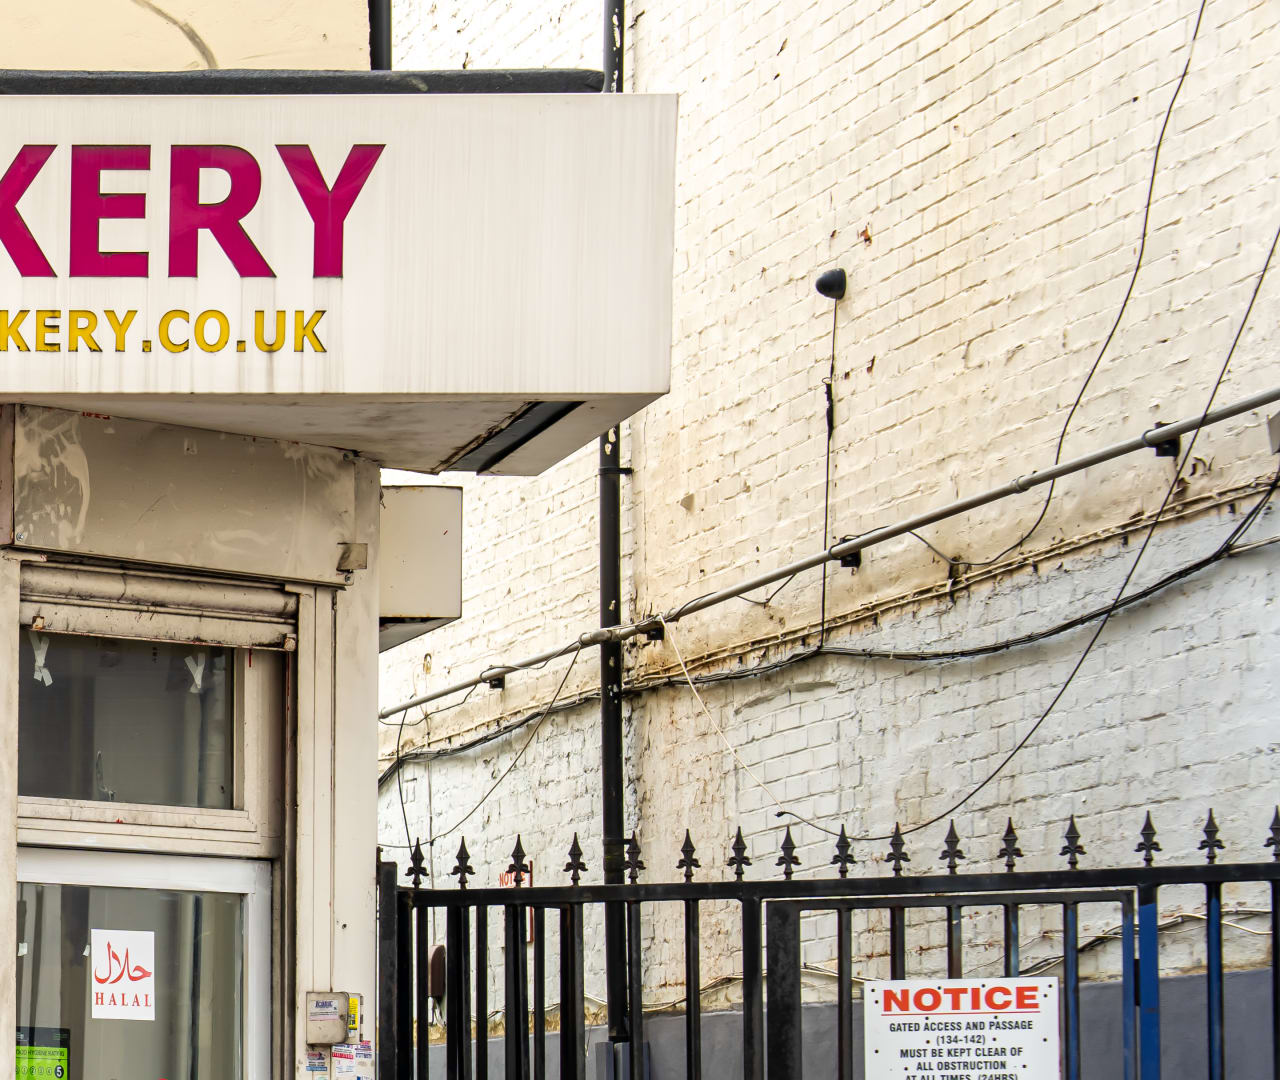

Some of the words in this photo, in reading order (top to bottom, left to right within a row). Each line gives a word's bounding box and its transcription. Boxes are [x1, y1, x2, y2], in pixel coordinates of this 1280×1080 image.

[94, 941, 153, 984] حلال
[95, 992, 152, 1007] HALAL
[883, 986, 1040, 1011] NOTICE
[890, 1023, 920, 1032] GATED
[924, 1022, 962, 1031] ACCESS
[966, 1022, 985, 1031] AND
[989, 1021, 1033, 1030] PASSAGE
[936, 1035, 986, 1045] (134-142)
[900, 1049, 928, 1058] MUST
[931, 1049, 943, 1057] BE
[947, 1048, 971, 1057] KEPT
[975, 1048, 1007, 1057] CLEAR
[1010, 1048, 1023, 1056] OF
[917, 1062, 933, 1071] ALL
[937, 1061, 1007, 1070] OBSTRUCTION
